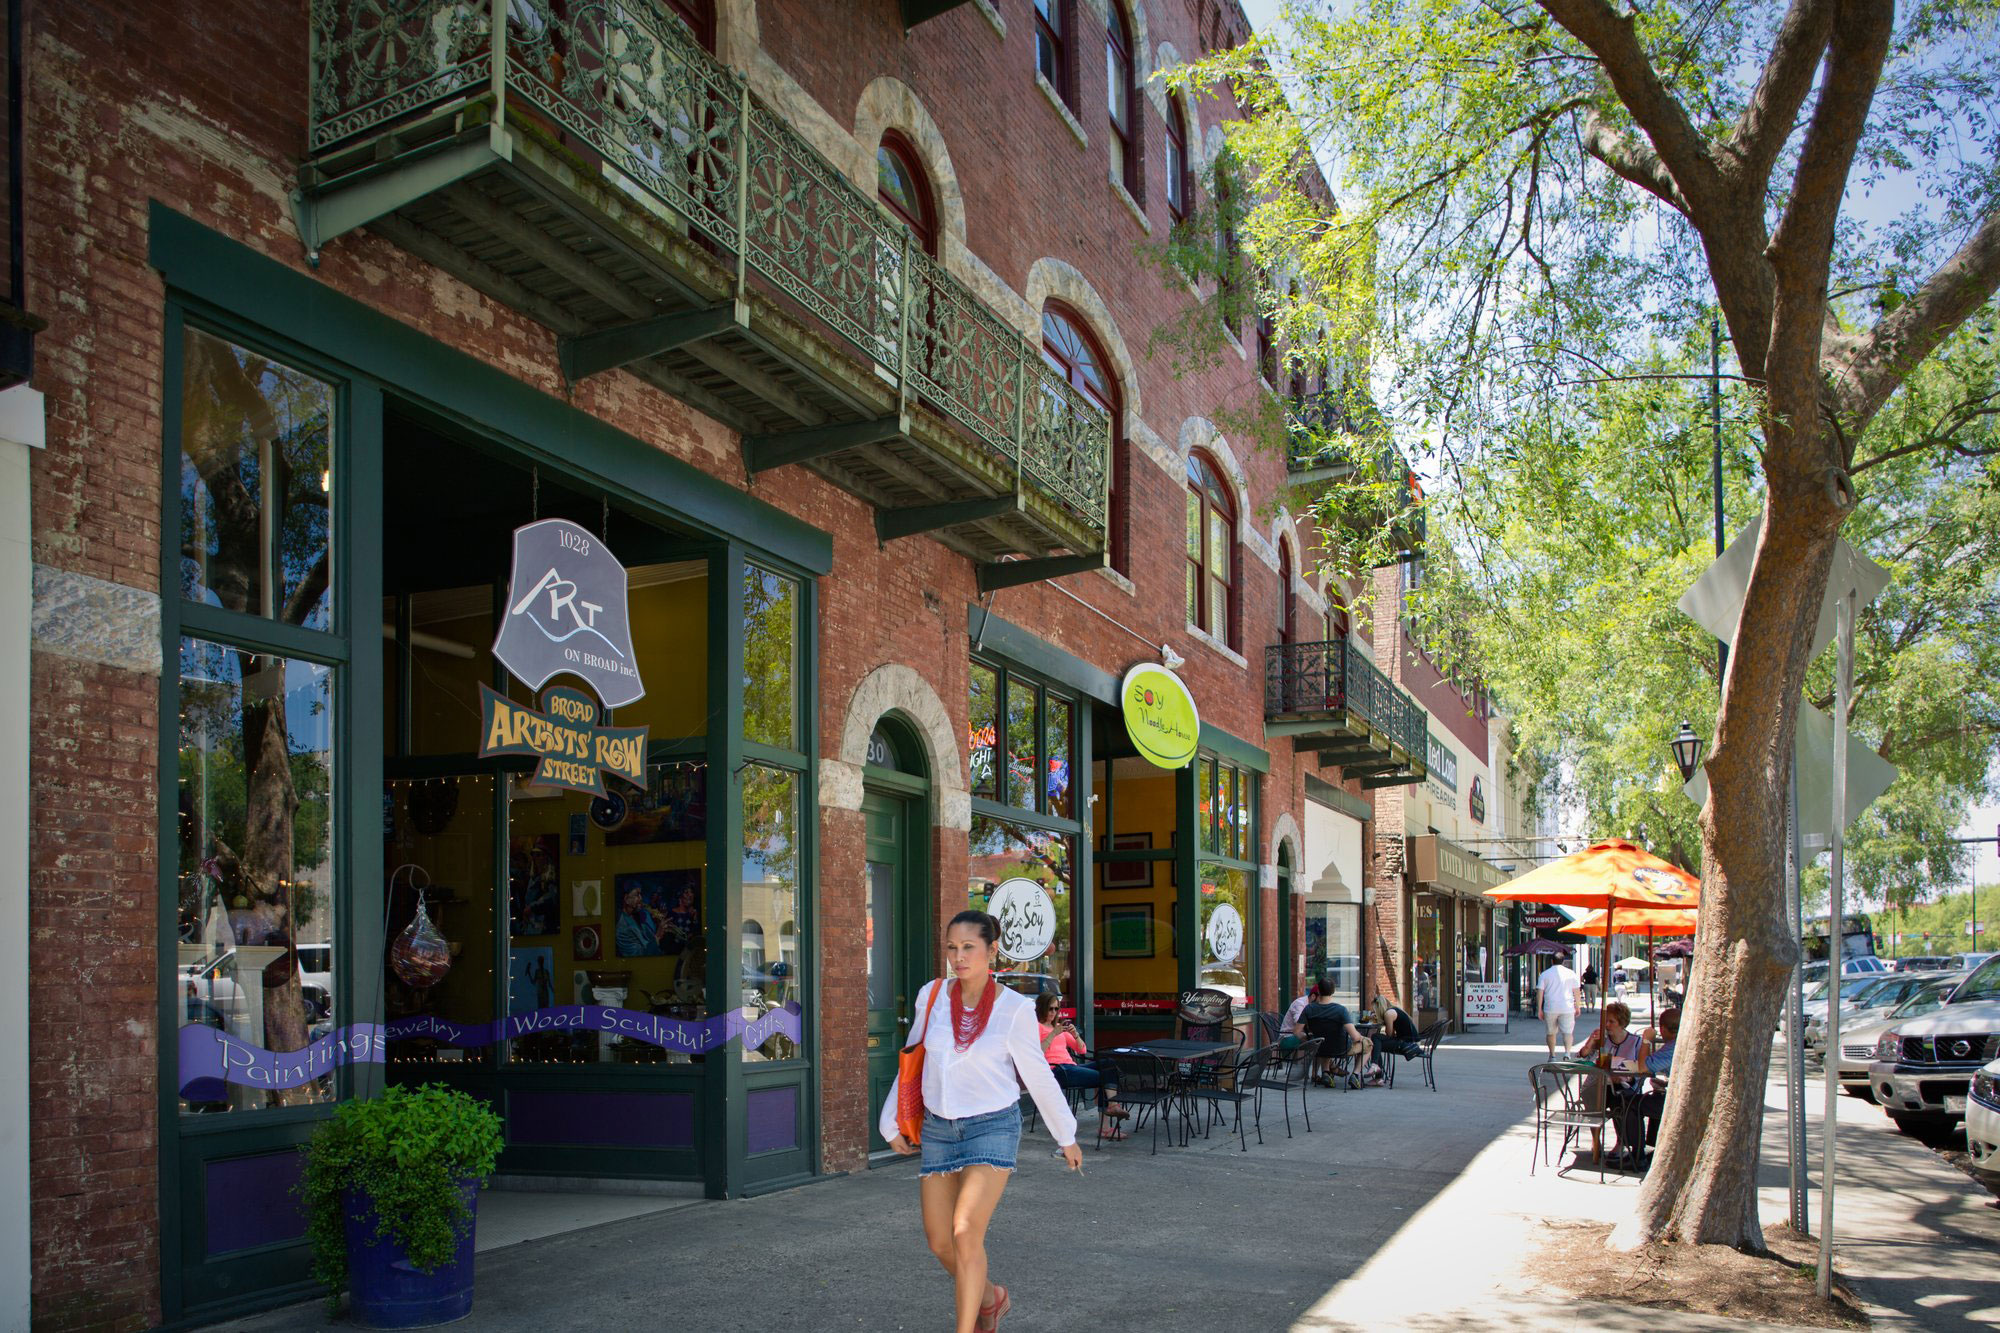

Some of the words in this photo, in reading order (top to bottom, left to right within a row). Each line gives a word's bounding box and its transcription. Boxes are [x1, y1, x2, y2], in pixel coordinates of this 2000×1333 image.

[558, 529, 591, 557] 1028
[512, 567, 603, 629] ART
[564, 647, 581, 663] ON
[583, 652, 619, 673] BROAD
[619, 662, 637, 678] inc.
[551, 694, 594, 724] BROAD
[486, 699, 592, 760] ARTISTS'
[595, 734, 645, 777] ROW
[542, 757, 596, 786] STREET
[969, 747, 993, 769] IGHT
[1426, 780, 1457, 811] FIREARMS
[1024, 901, 1044, 936] Soy
[1525, 915, 1561, 925] WHISKEY
[1180, 991, 1228, 1005] Yuengling
[216, 1032, 386, 1084] Paintings
[385, 1016, 462, 1042] ewelry
[513, 1007, 585, 1034] Wood
[744, 1013, 786, 1047] Gifts
